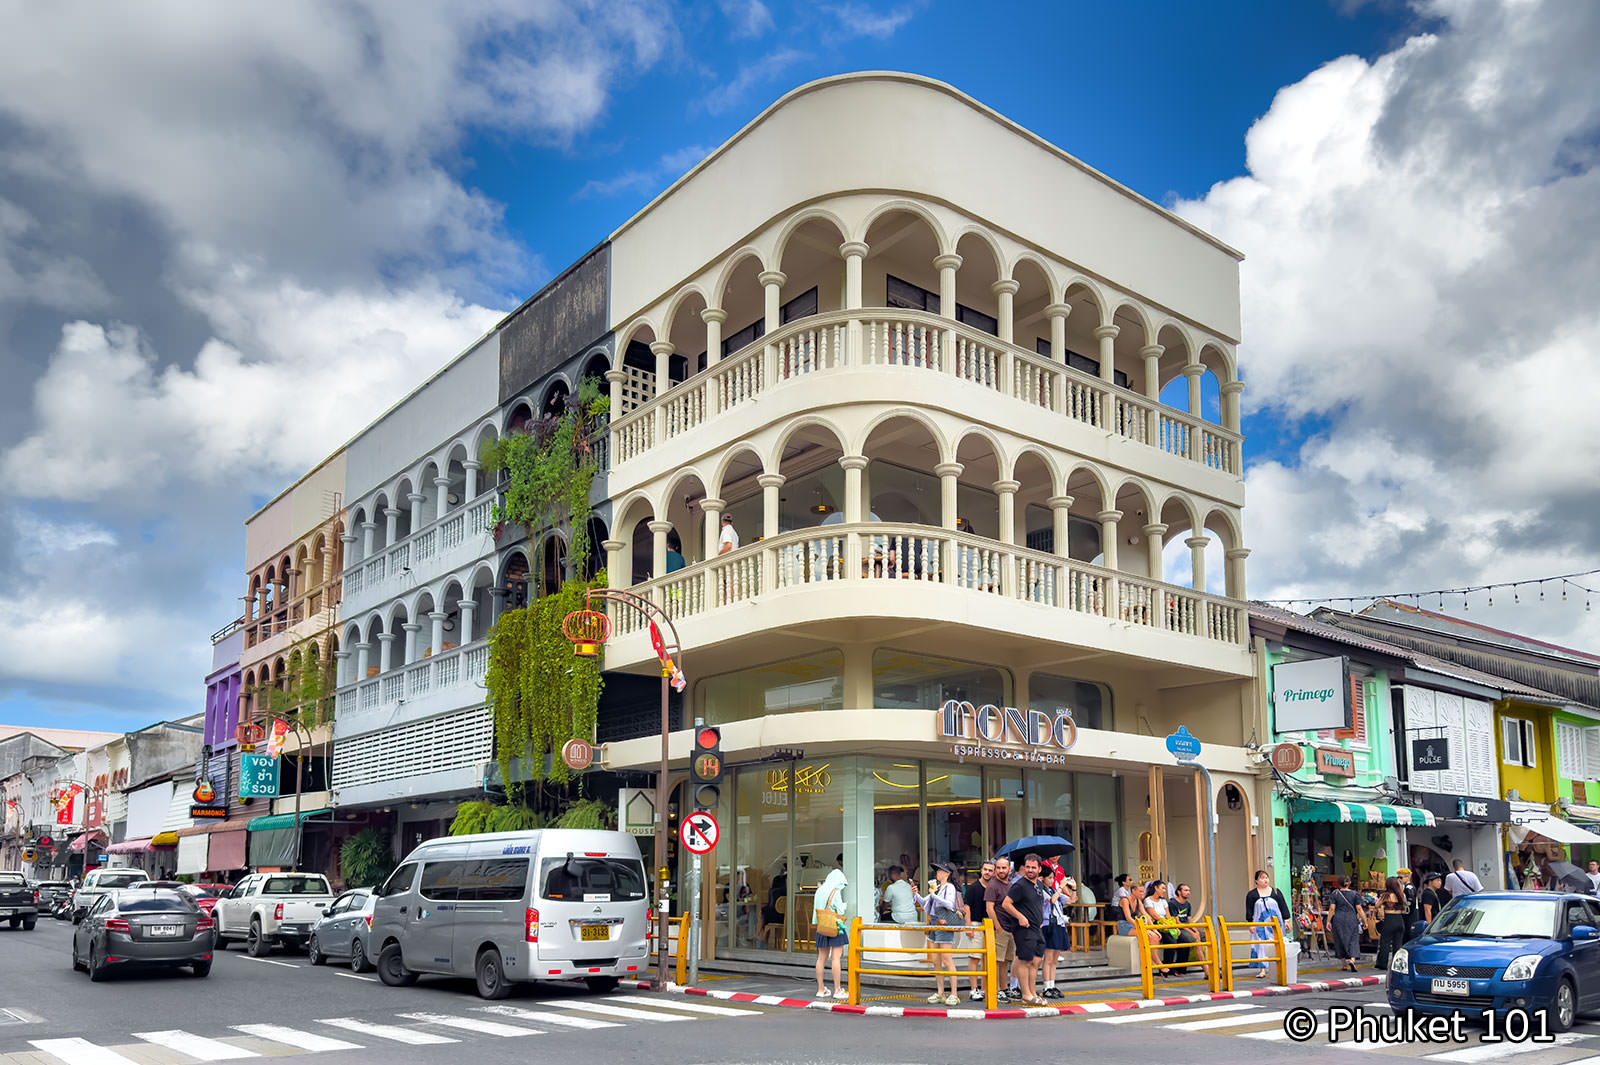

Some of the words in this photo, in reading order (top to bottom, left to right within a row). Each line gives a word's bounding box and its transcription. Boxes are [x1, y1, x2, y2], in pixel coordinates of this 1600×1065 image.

[1283, 687, 1335, 703] Primego
[938, 699, 1078, 749] MONDO
[251, 757, 274, 767] ของ
[954, 744, 1008, 760] ESPRESSO
[1013, 752, 1020, 761] &
[1047, 753, 1066, 765] BAR
[1323, 752, 1350, 771] Primego
[1419, 756, 1442, 764] PULSE
[703, 759, 719, 776] 14
[251, 781, 275, 793] ร่วย
[1466, 801, 1488, 816] PULSE
[1447, 980, 1466, 989] 5955
